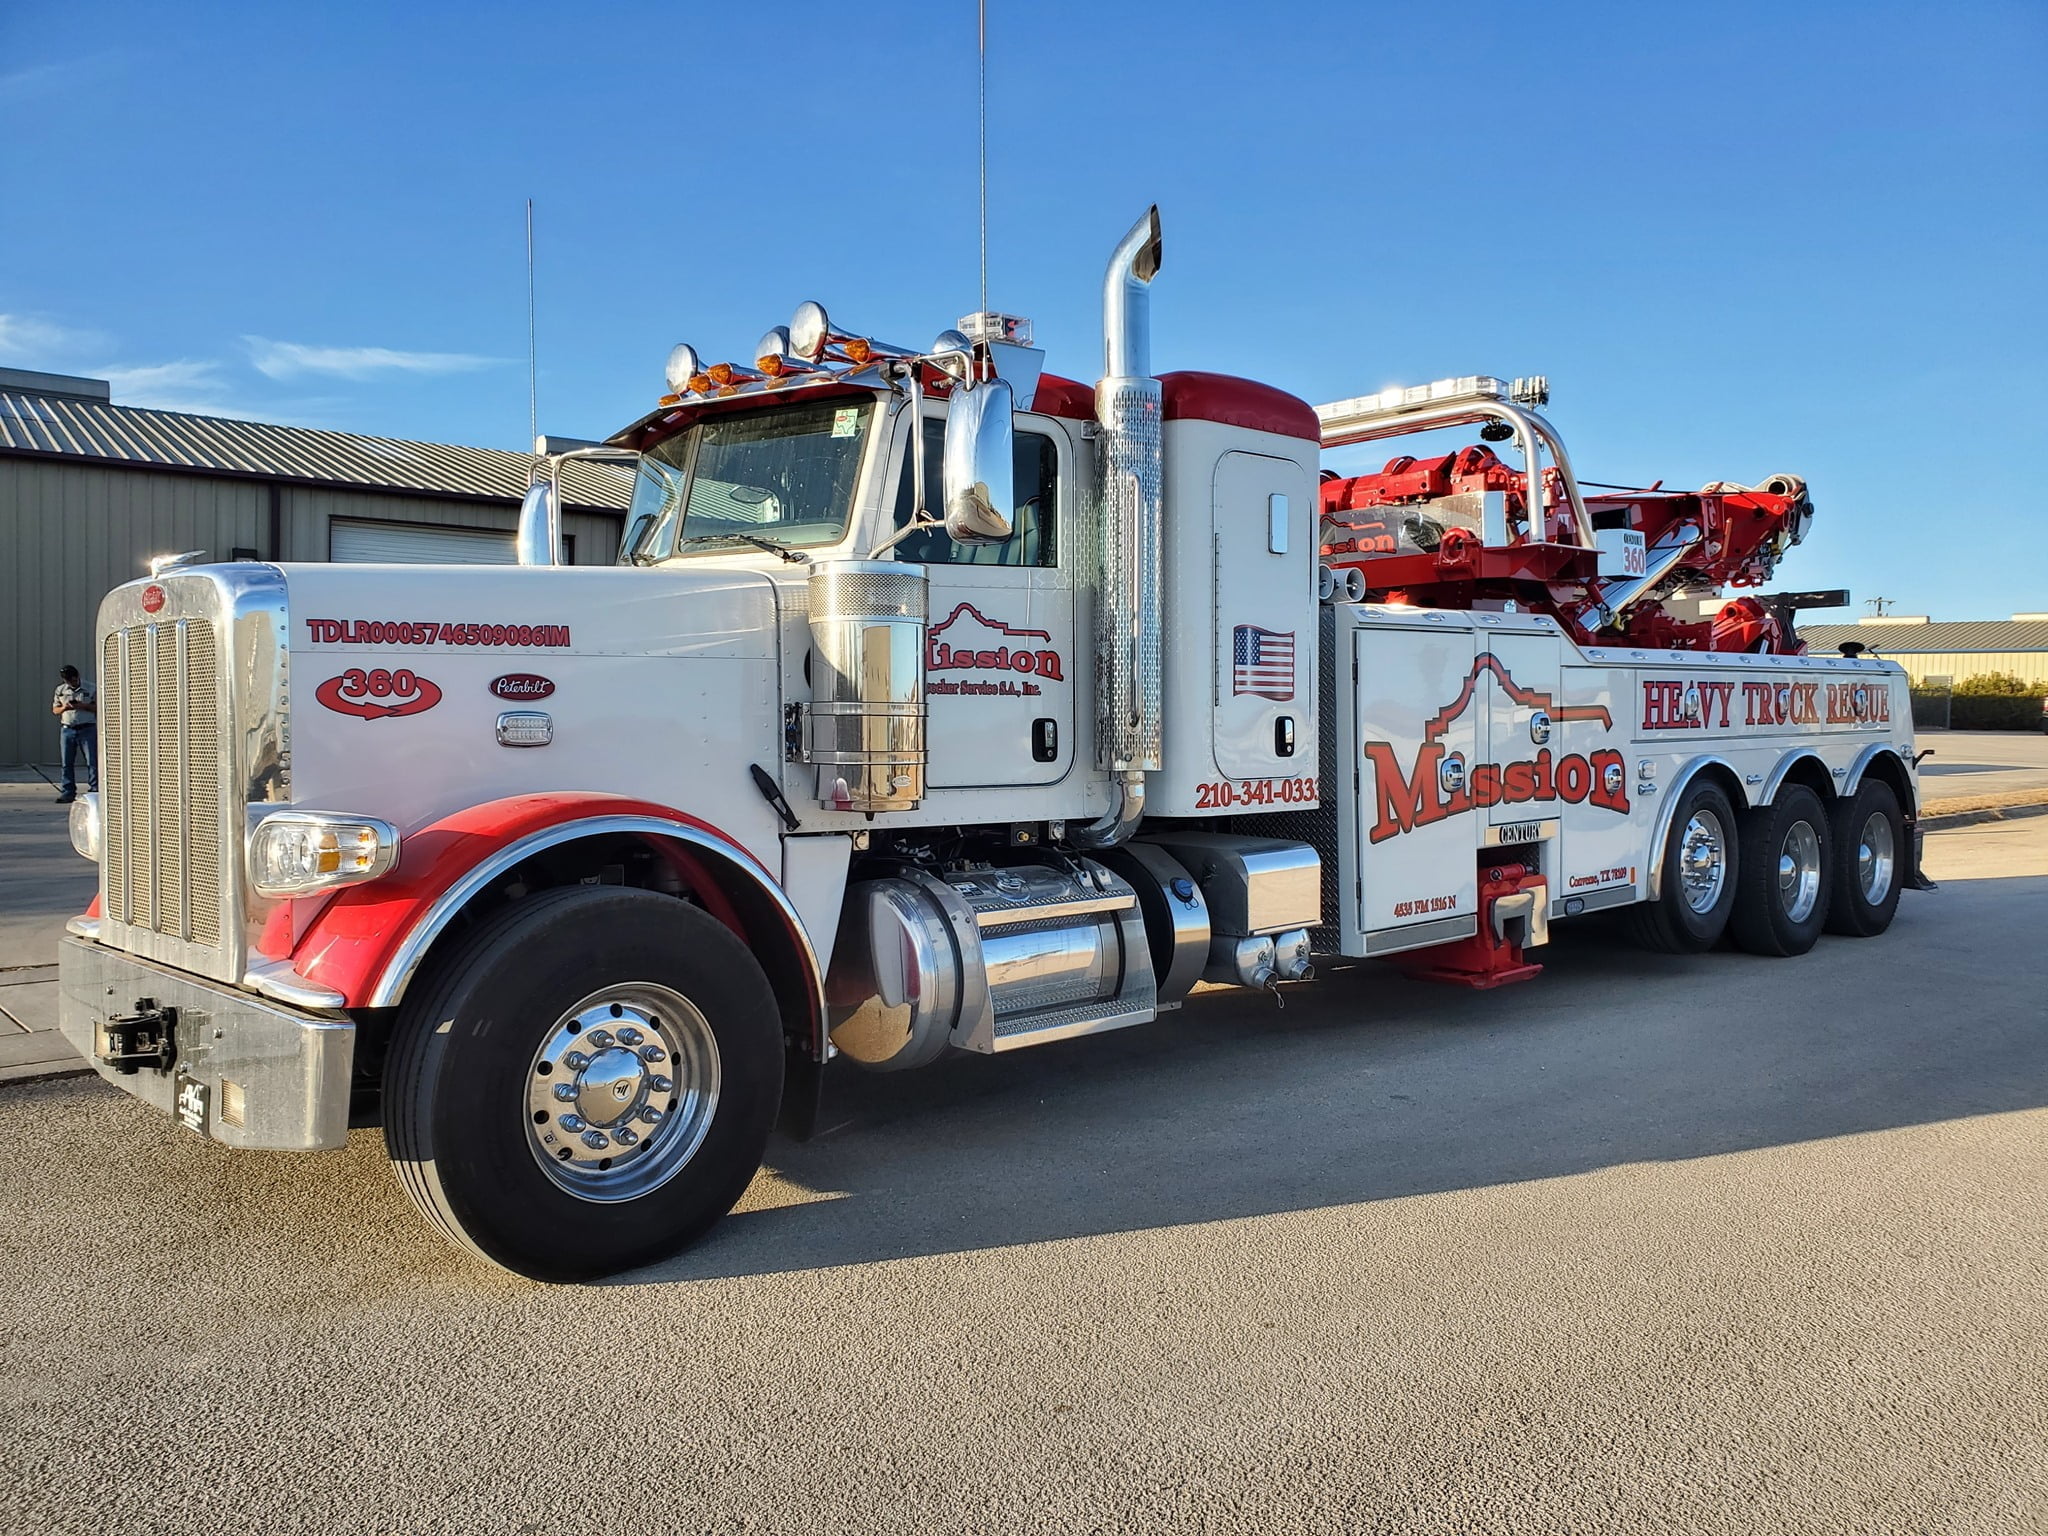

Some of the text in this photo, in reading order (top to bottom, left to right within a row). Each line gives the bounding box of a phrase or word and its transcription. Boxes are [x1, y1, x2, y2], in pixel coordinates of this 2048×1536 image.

[1320, 534, 1397, 557] ssion
[1623, 546, 1645, 574] 360
[306, 619, 571, 647] TDLR0005746509086IM
[343, 668, 417, 698] 360
[497, 678, 551, 694] Peterbilt
[960, 680, 998, 695] Service
[1022, 681, 1041, 695] Inc.
[1742, 681, 1820, 726] TRUCK
[1825, 683, 1889, 724] RESCUE
[1364, 741, 1630, 844] Mission
[1500, 822, 1541, 844] CENTURY
[1600, 869, 1611, 882] TX
[1414, 899, 1430, 914] FM
[1448, 894, 1457, 909] N
